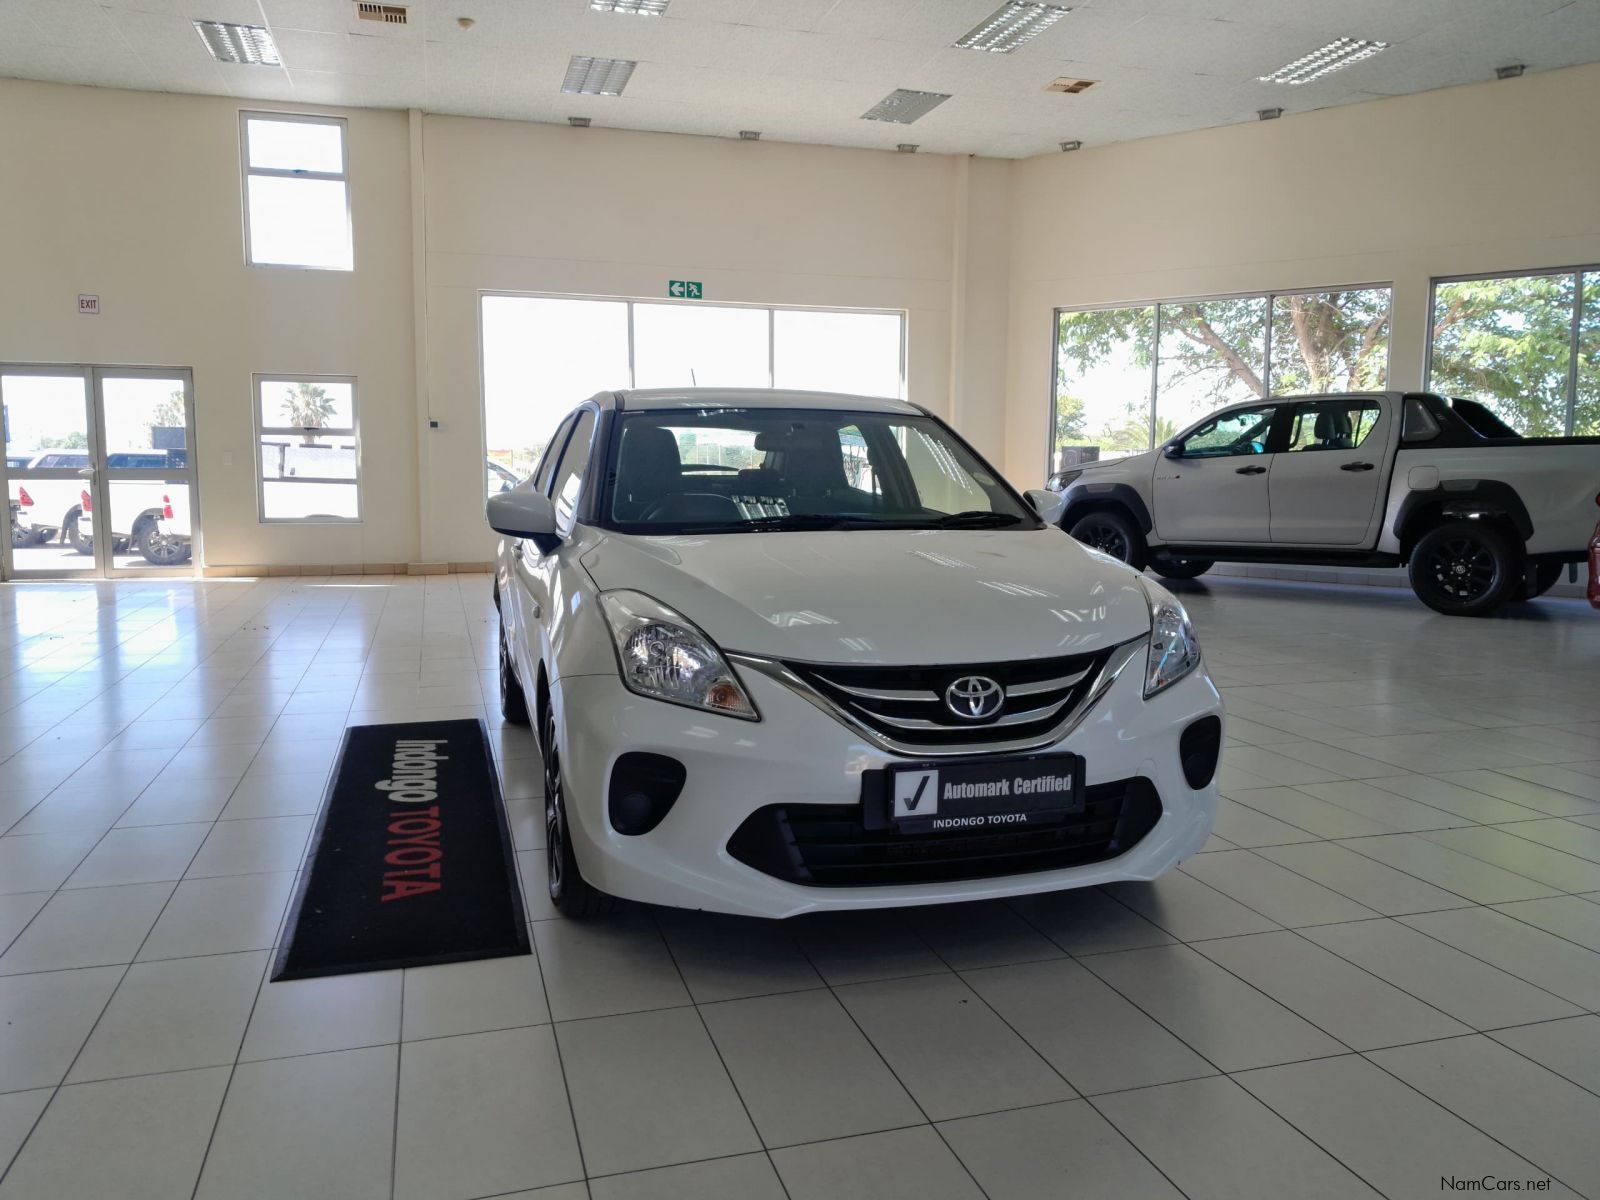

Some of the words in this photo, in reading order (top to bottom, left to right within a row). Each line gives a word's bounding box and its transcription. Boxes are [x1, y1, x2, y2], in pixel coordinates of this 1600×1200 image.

[80, 299, 97, 309] EXIT
[374, 739, 449, 802] Indongo
[943, 779, 1010, 800] Automark
[1013, 774, 1072, 795] Certified
[933, 816, 985, 829] INDONGO
[987, 813, 1027, 824] TOYOTA
[381, 806, 442, 902] TOYOTA
